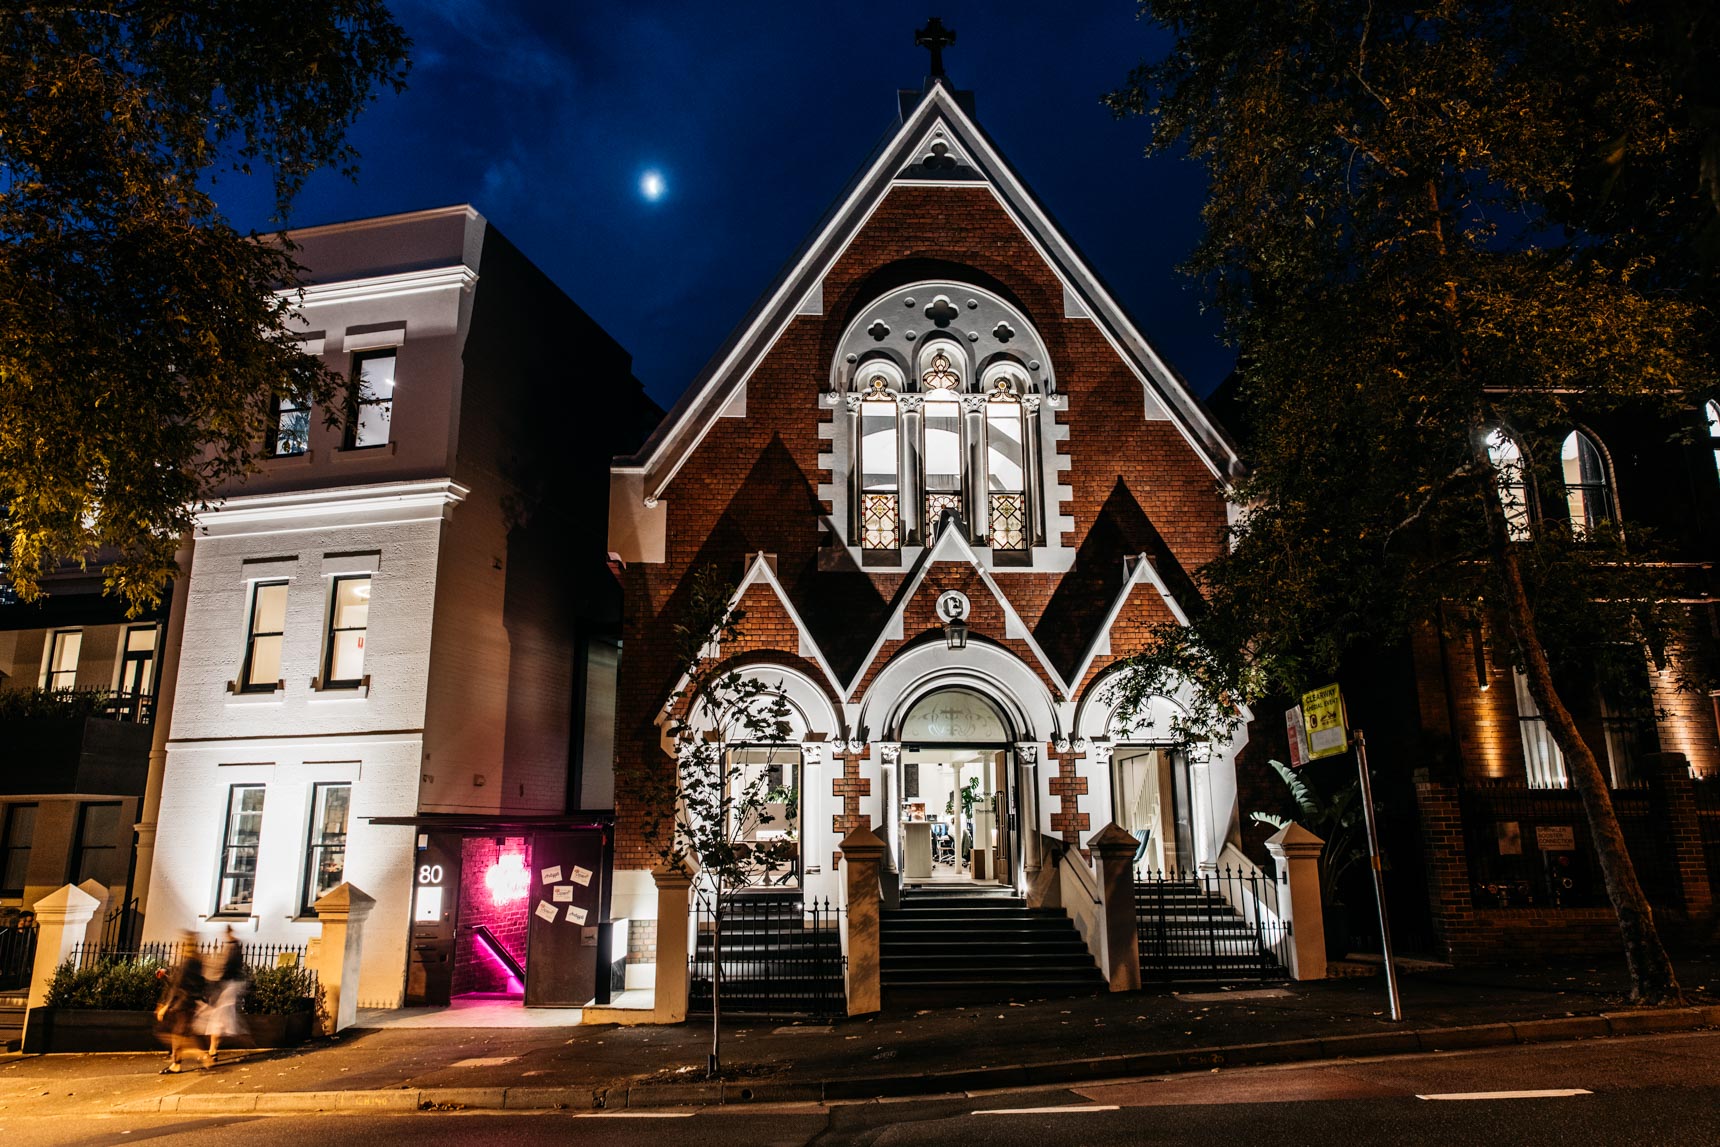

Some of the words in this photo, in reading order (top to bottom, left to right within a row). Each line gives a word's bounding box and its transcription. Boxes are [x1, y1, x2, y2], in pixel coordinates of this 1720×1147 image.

[1305, 688, 1336, 704] CLEARWAY
[1323, 697, 1338, 707] EVENT
[419, 865, 443, 884] 80
